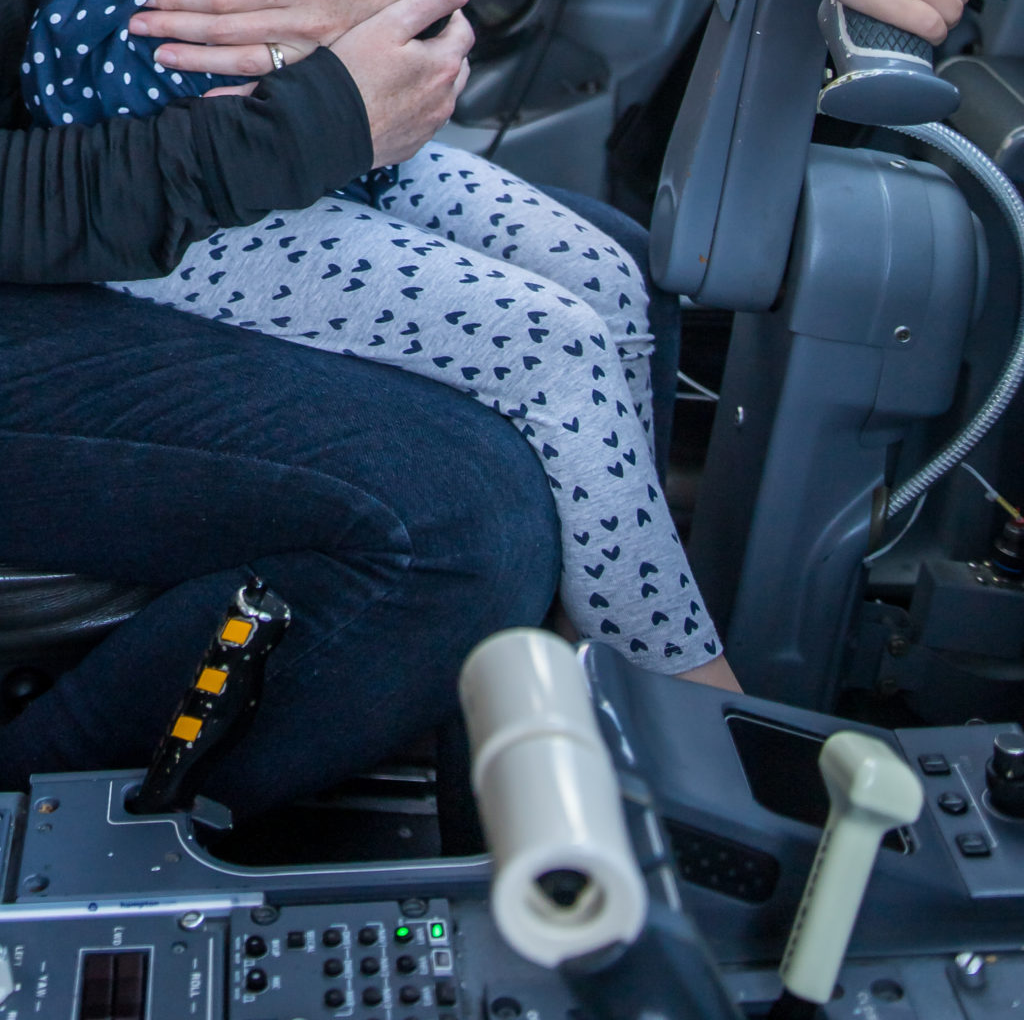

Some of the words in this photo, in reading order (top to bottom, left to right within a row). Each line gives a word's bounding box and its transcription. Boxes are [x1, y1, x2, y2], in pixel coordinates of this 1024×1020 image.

[14, 945, 24, 966] LEFT
[36, 975, 48, 997] YAW
[190, 973, 201, 998] ROLL
